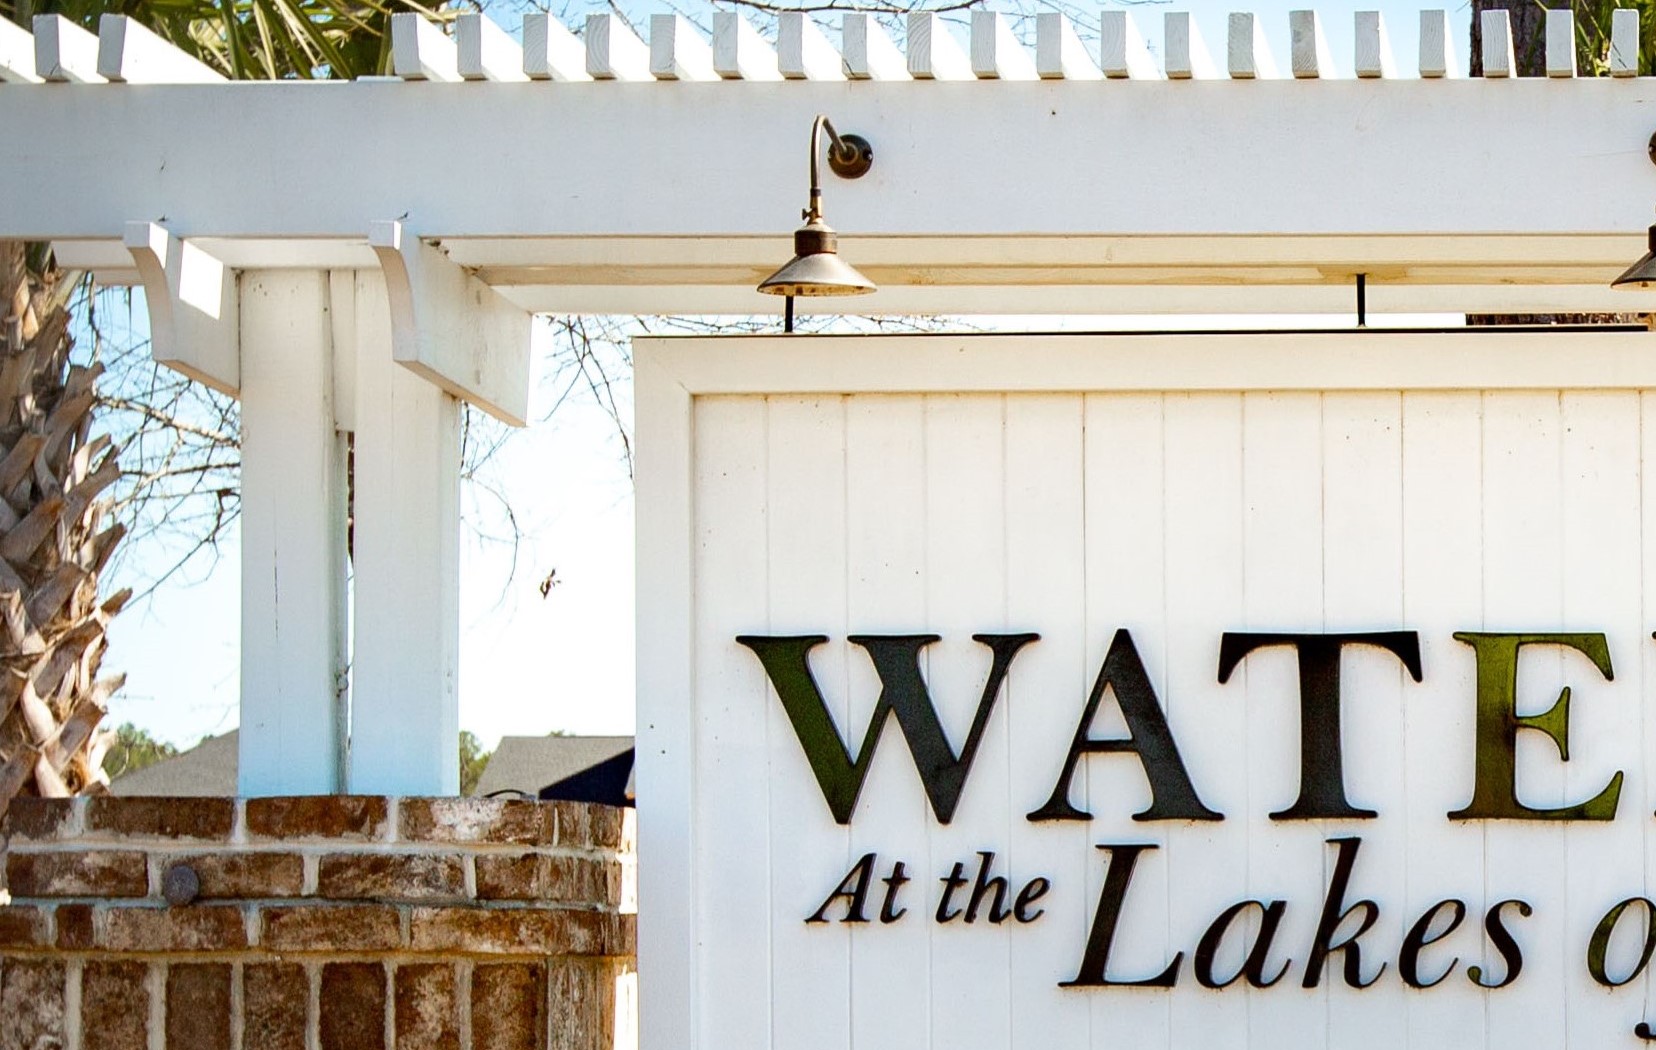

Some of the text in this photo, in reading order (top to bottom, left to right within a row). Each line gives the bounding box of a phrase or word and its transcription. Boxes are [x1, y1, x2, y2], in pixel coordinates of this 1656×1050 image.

[803, 851, 912, 927] At
[935, 850, 1050, 927] the
[1056, 835, 1534, 993] Lakes
